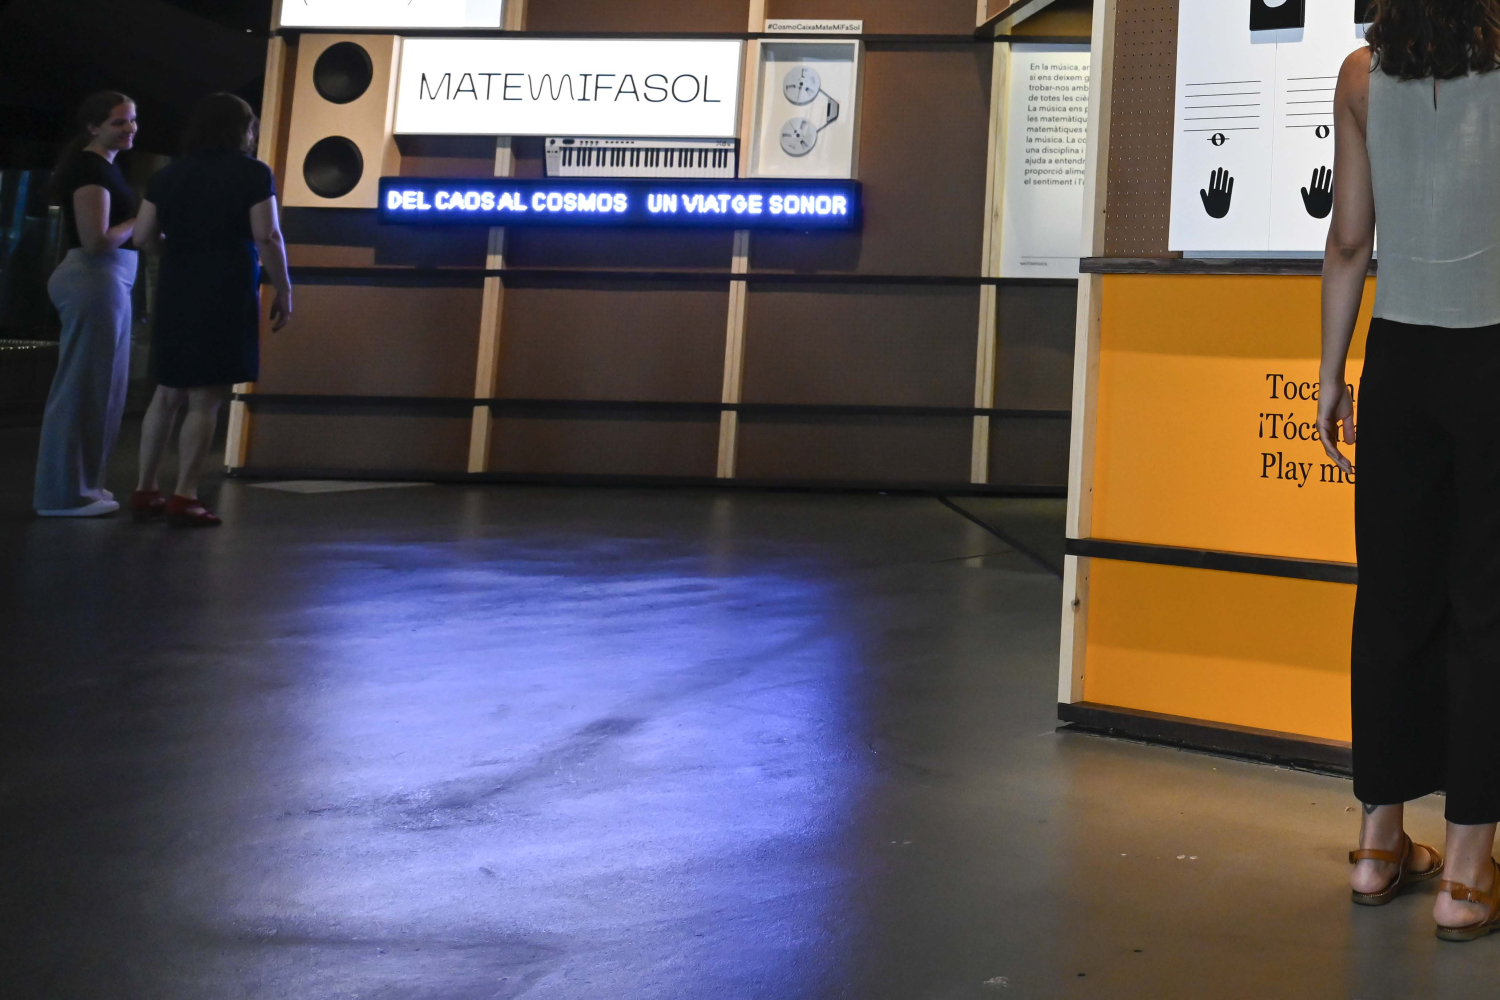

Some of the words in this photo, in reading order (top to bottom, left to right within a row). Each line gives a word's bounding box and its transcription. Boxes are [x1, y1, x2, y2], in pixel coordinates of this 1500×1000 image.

[767, 22, 860, 31] #CosmoCaixaMateMiFaSol
[419, 72, 721, 103] MATEMIFASOL
[387, 190, 431, 210] DEL
[435, 191, 495, 210] CAOS
[497, 192, 528, 211] AL
[532, 192, 628, 212] COSMOS
[648, 193, 677, 213] UN
[682, 194, 763, 214] VIATGE
[769, 195, 847, 215] SONOR
[1266, 373, 1355, 402] Toca
[1259, 412, 1356, 442] ¡Tóca
[1260, 451, 1313, 488] Play
